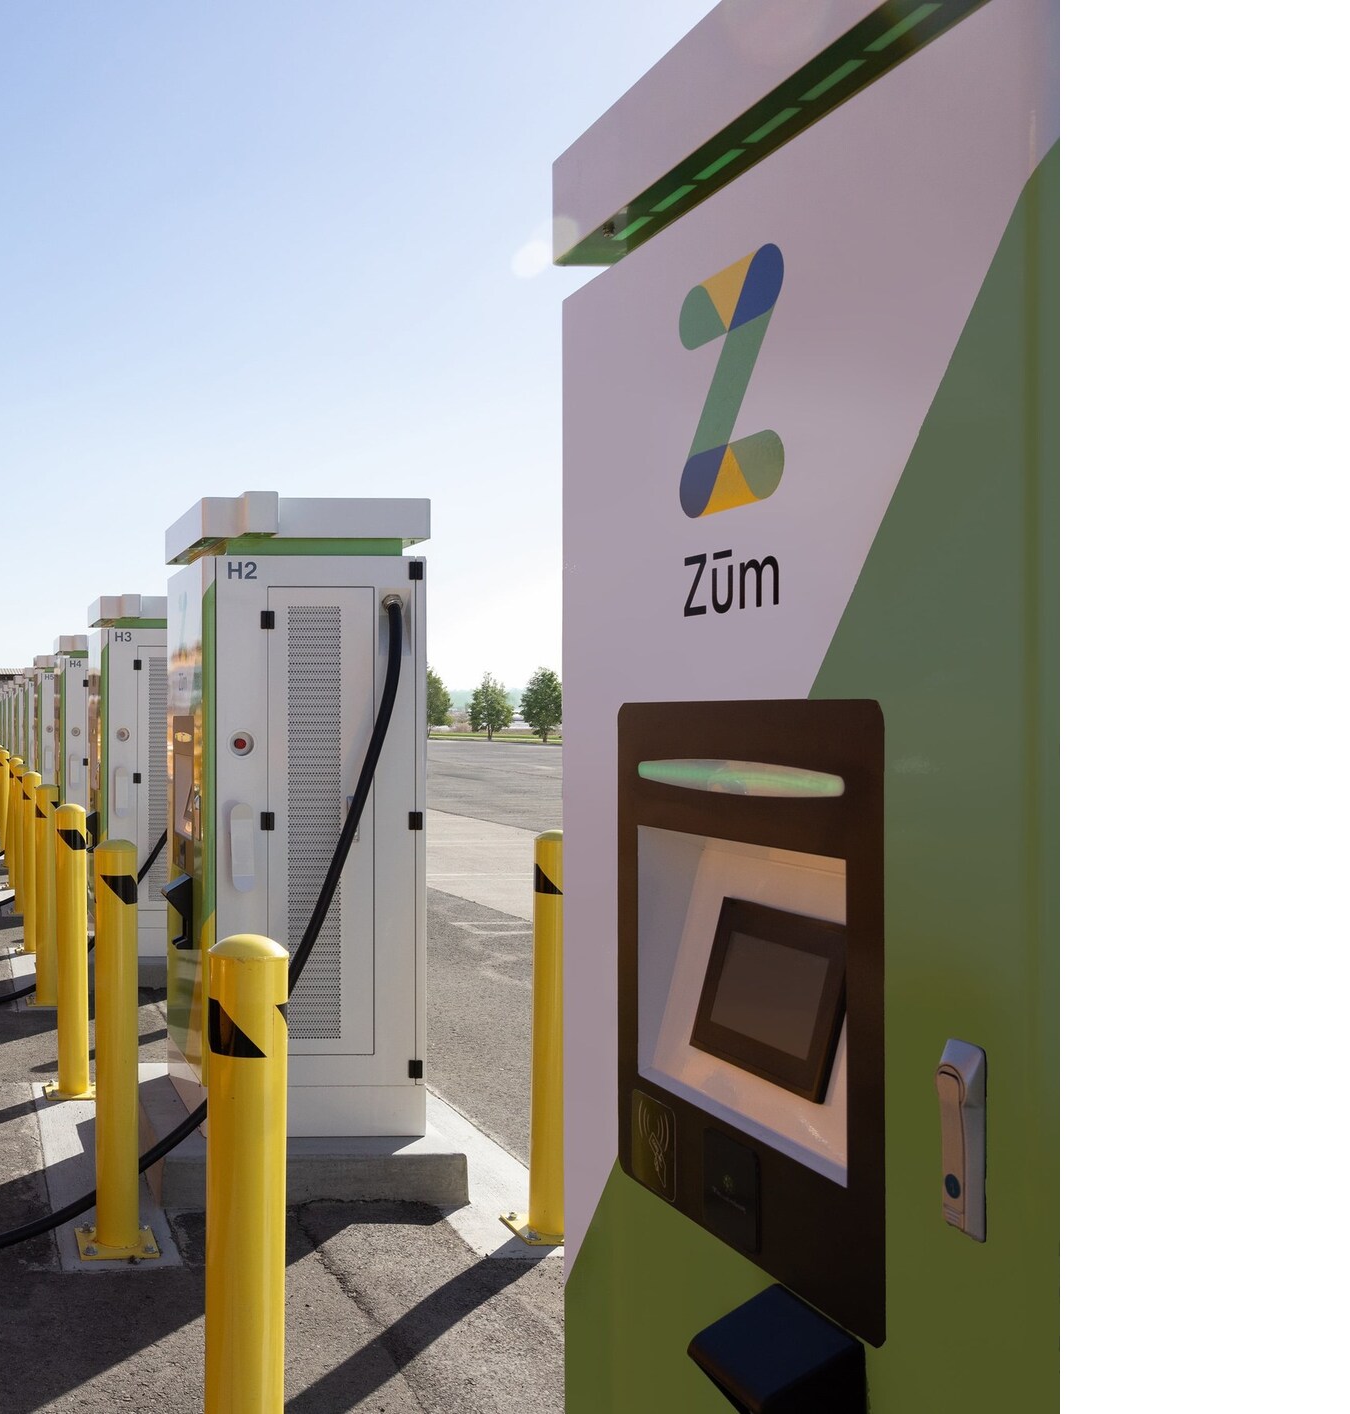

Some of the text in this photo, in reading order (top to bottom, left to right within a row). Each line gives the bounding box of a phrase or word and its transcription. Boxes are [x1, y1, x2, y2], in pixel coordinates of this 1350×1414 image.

[227, 561, 257, 579] H2
[684, 549, 779, 617] Zūm
[114, 631, 132, 642] H3
[69, 660, 82, 668] H4
